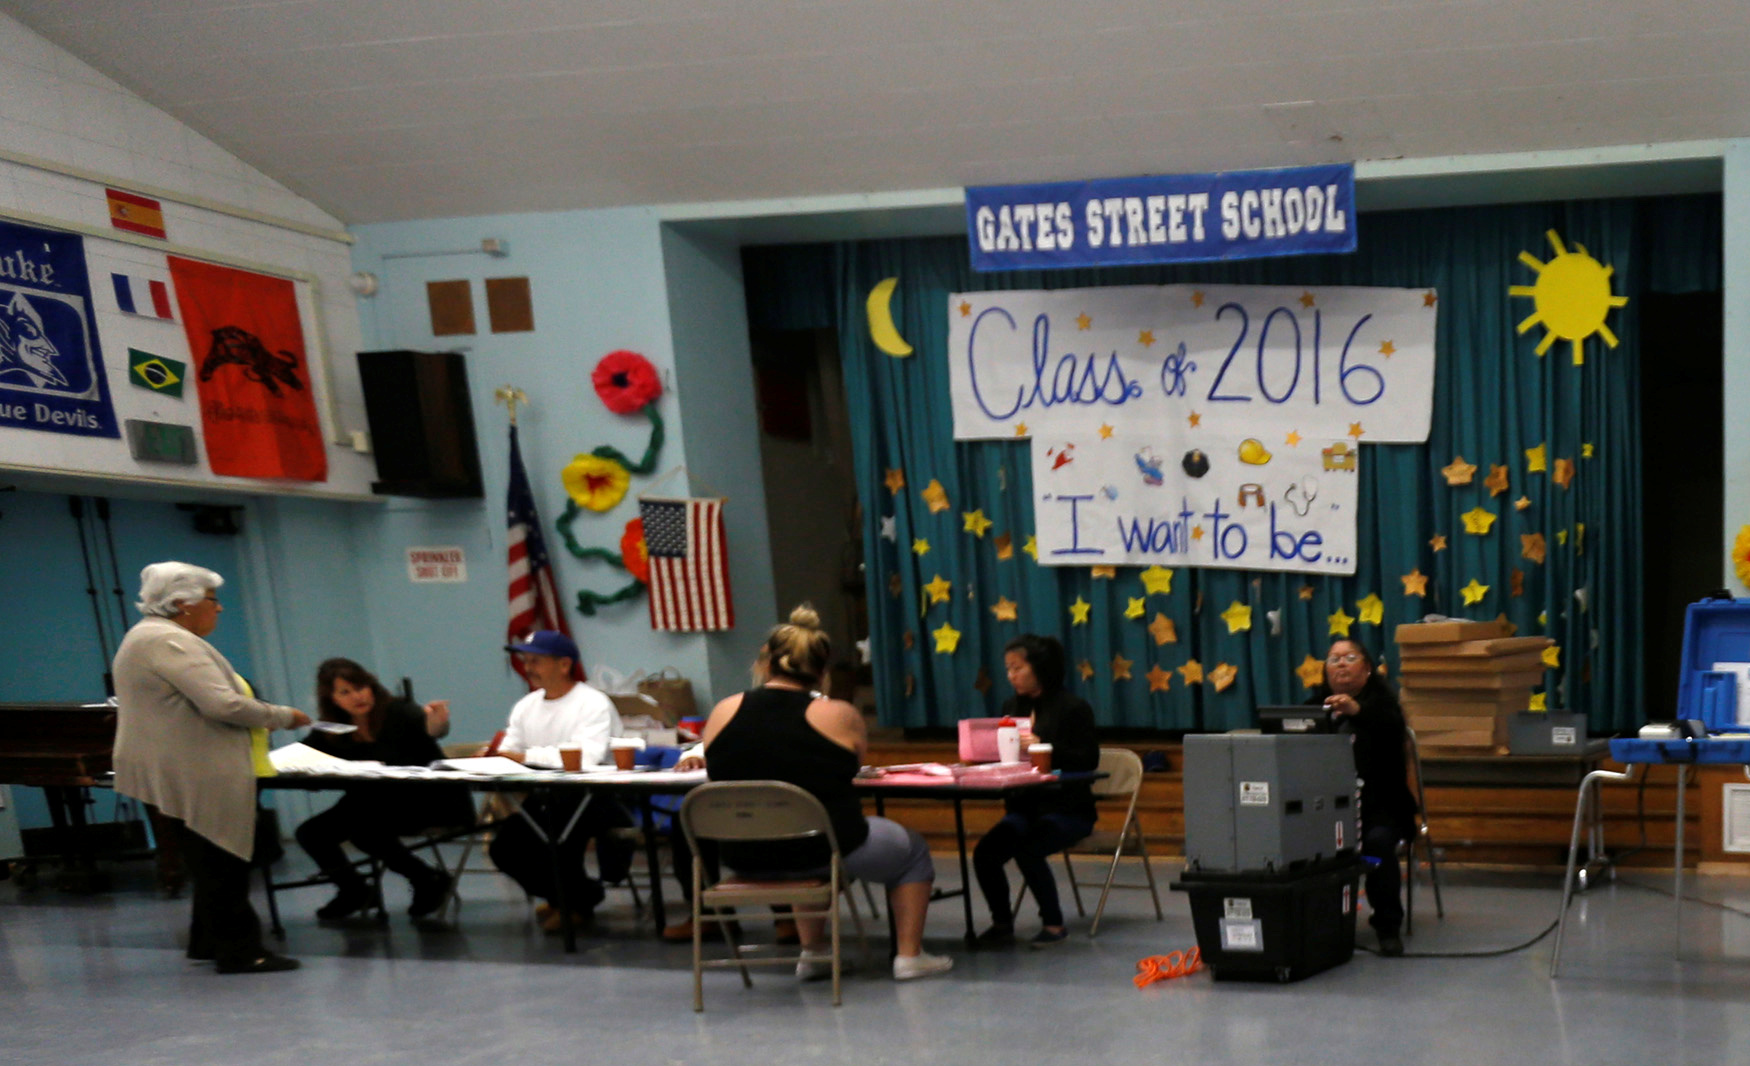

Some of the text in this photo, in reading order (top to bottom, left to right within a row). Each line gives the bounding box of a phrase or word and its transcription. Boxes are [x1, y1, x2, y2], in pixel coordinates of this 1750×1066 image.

[975, 183, 1347, 253] GATES STREET SCHOOL
[0, 249, 55, 286] uke
[968, 302, 1385, 421] Class of 2016
[0, 403, 27, 420] ue
[1117, 496, 1195, 554] want
[1202, 497, 1248, 560] to
